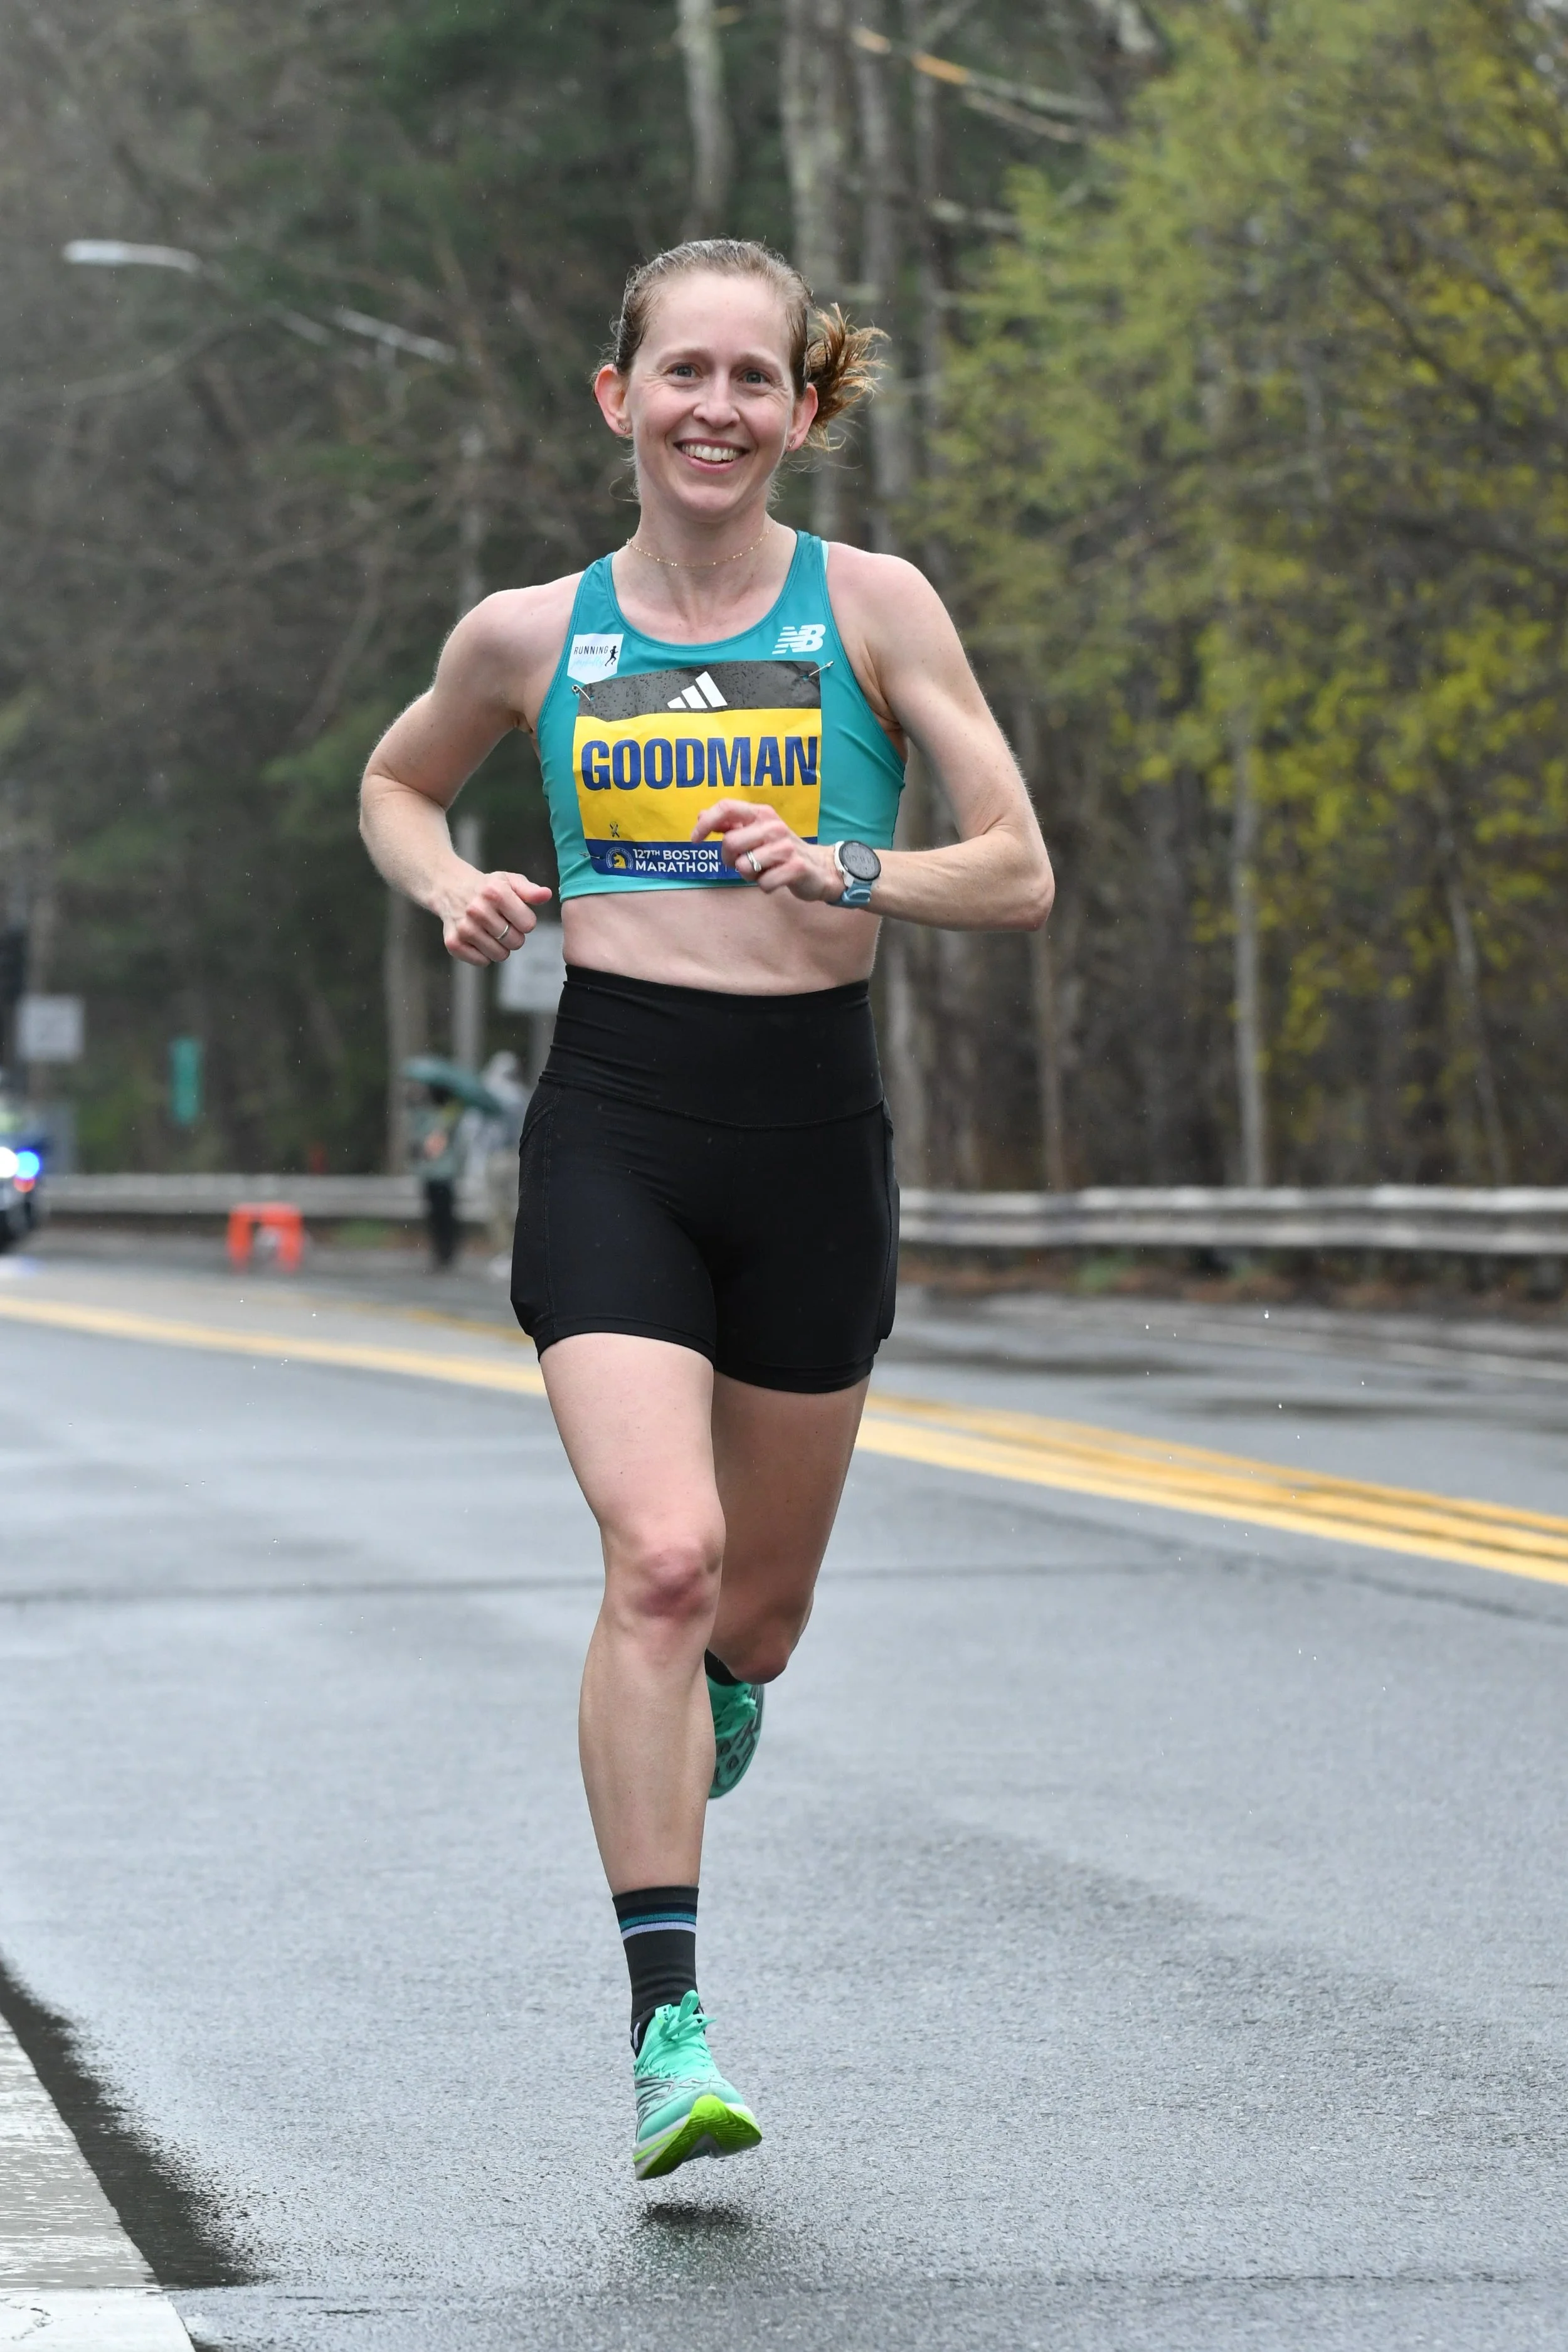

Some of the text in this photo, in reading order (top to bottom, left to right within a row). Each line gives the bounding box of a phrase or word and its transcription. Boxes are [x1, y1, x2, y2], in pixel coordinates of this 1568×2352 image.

[771, 623, 826, 655] NB
[574, 645, 608, 655] RUNNING
[581, 736, 818, 791] GOODMAN
[633, 849, 660, 859] 127TH
[663, 849, 718, 860] BOSTON
